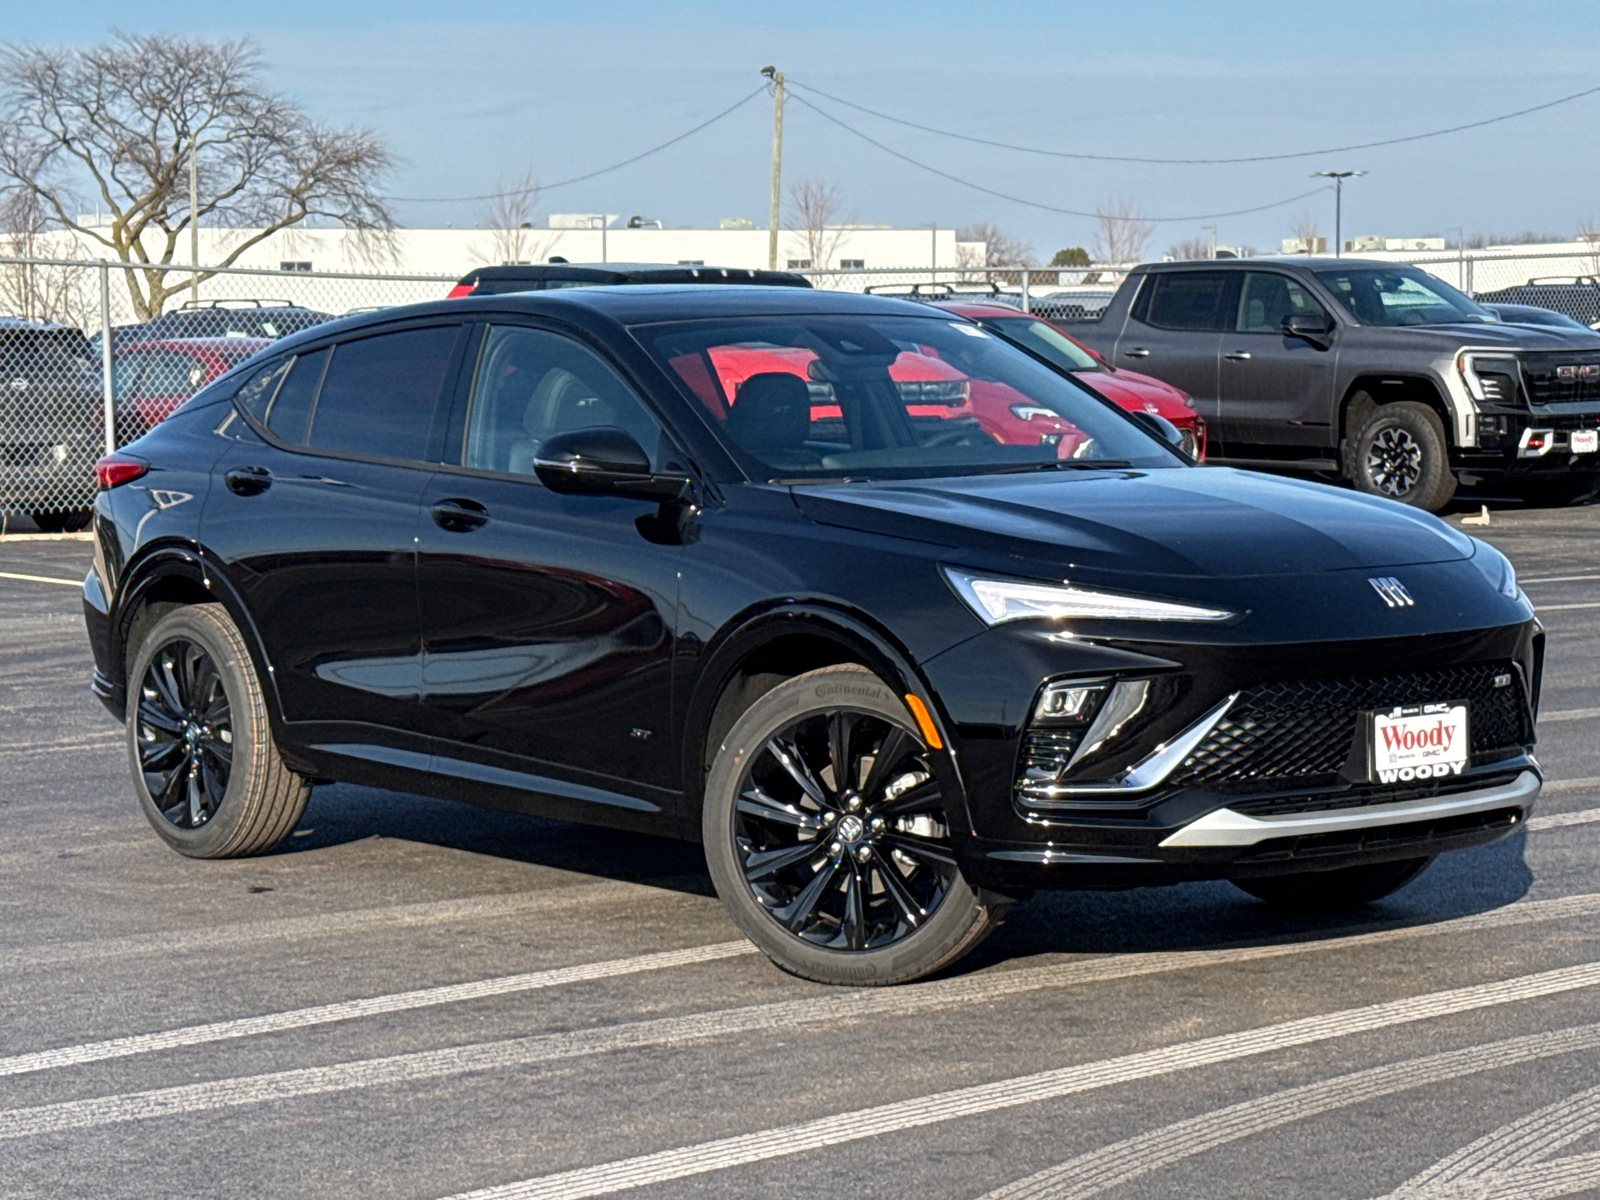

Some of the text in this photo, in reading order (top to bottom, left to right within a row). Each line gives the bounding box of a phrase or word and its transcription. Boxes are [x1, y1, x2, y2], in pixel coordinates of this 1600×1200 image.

[1557, 365, 1600, 379] GMC
[814, 684, 881, 698] Continental
[1424, 702, 1448, 714] GMC
[1380, 719, 1457, 753] Woody
[1378, 760, 1466, 784] WOODY
